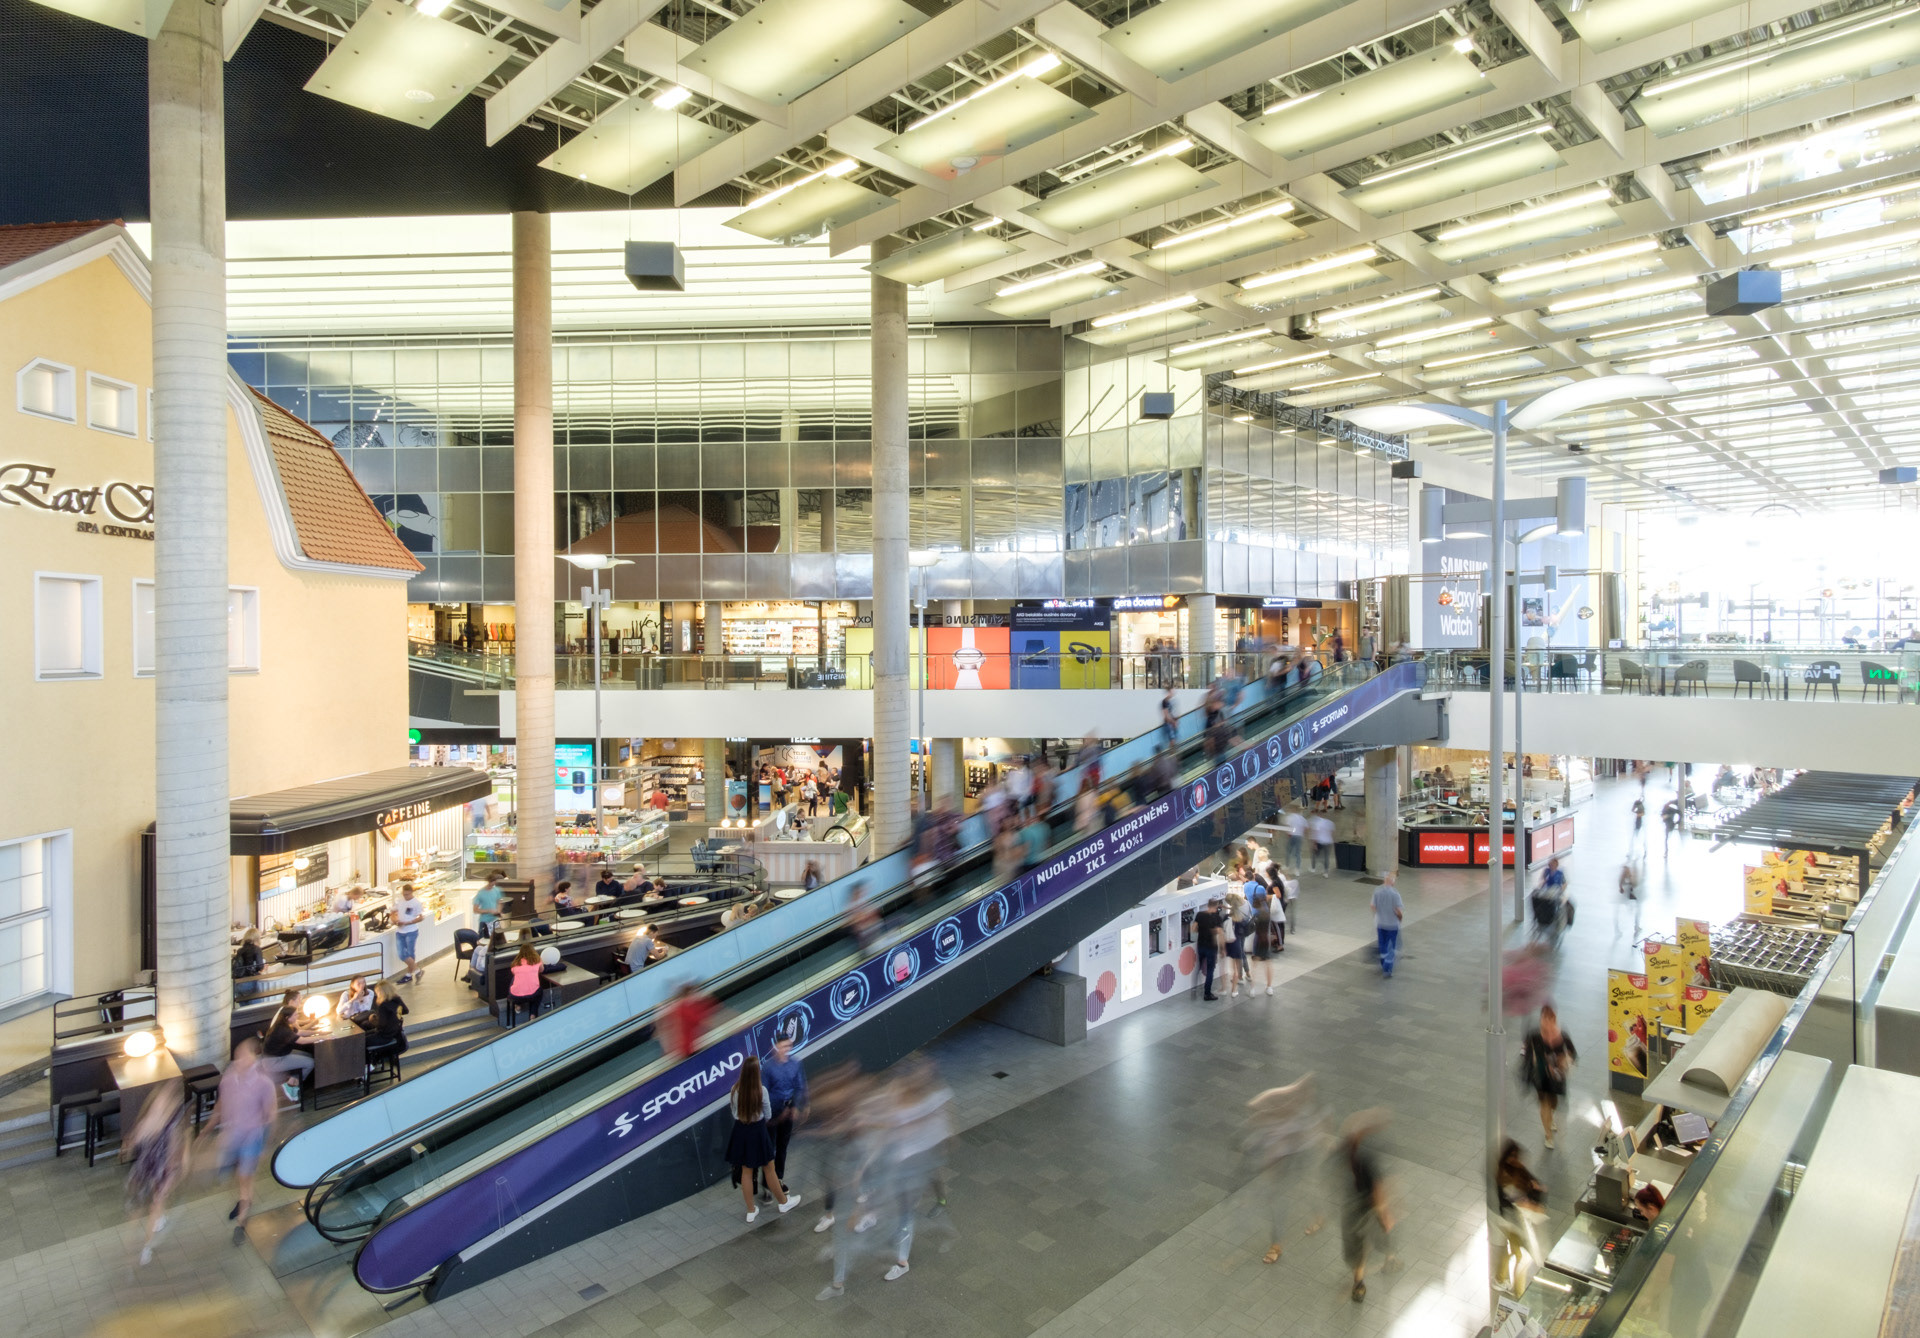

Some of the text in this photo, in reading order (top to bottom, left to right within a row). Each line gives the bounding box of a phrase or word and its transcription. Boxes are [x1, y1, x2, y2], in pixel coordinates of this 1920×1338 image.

[0, 463, 103, 515] East
[77, 521, 155, 541] SPA CENTRAS
[1113, 597, 1163, 609] gera dovana
[1440, 615, 1473, 636] Watch
[1319, 704, 1349, 729] SPORTLAND
[376, 800, 432, 827] CAFFEINE
[1036, 802, 1170, 886] NUOLAIDOS KUPRINĖMS
[1085, 832, 1144, 875] IKI -40%!
[641, 1051, 744, 1122] SPORTLAND
